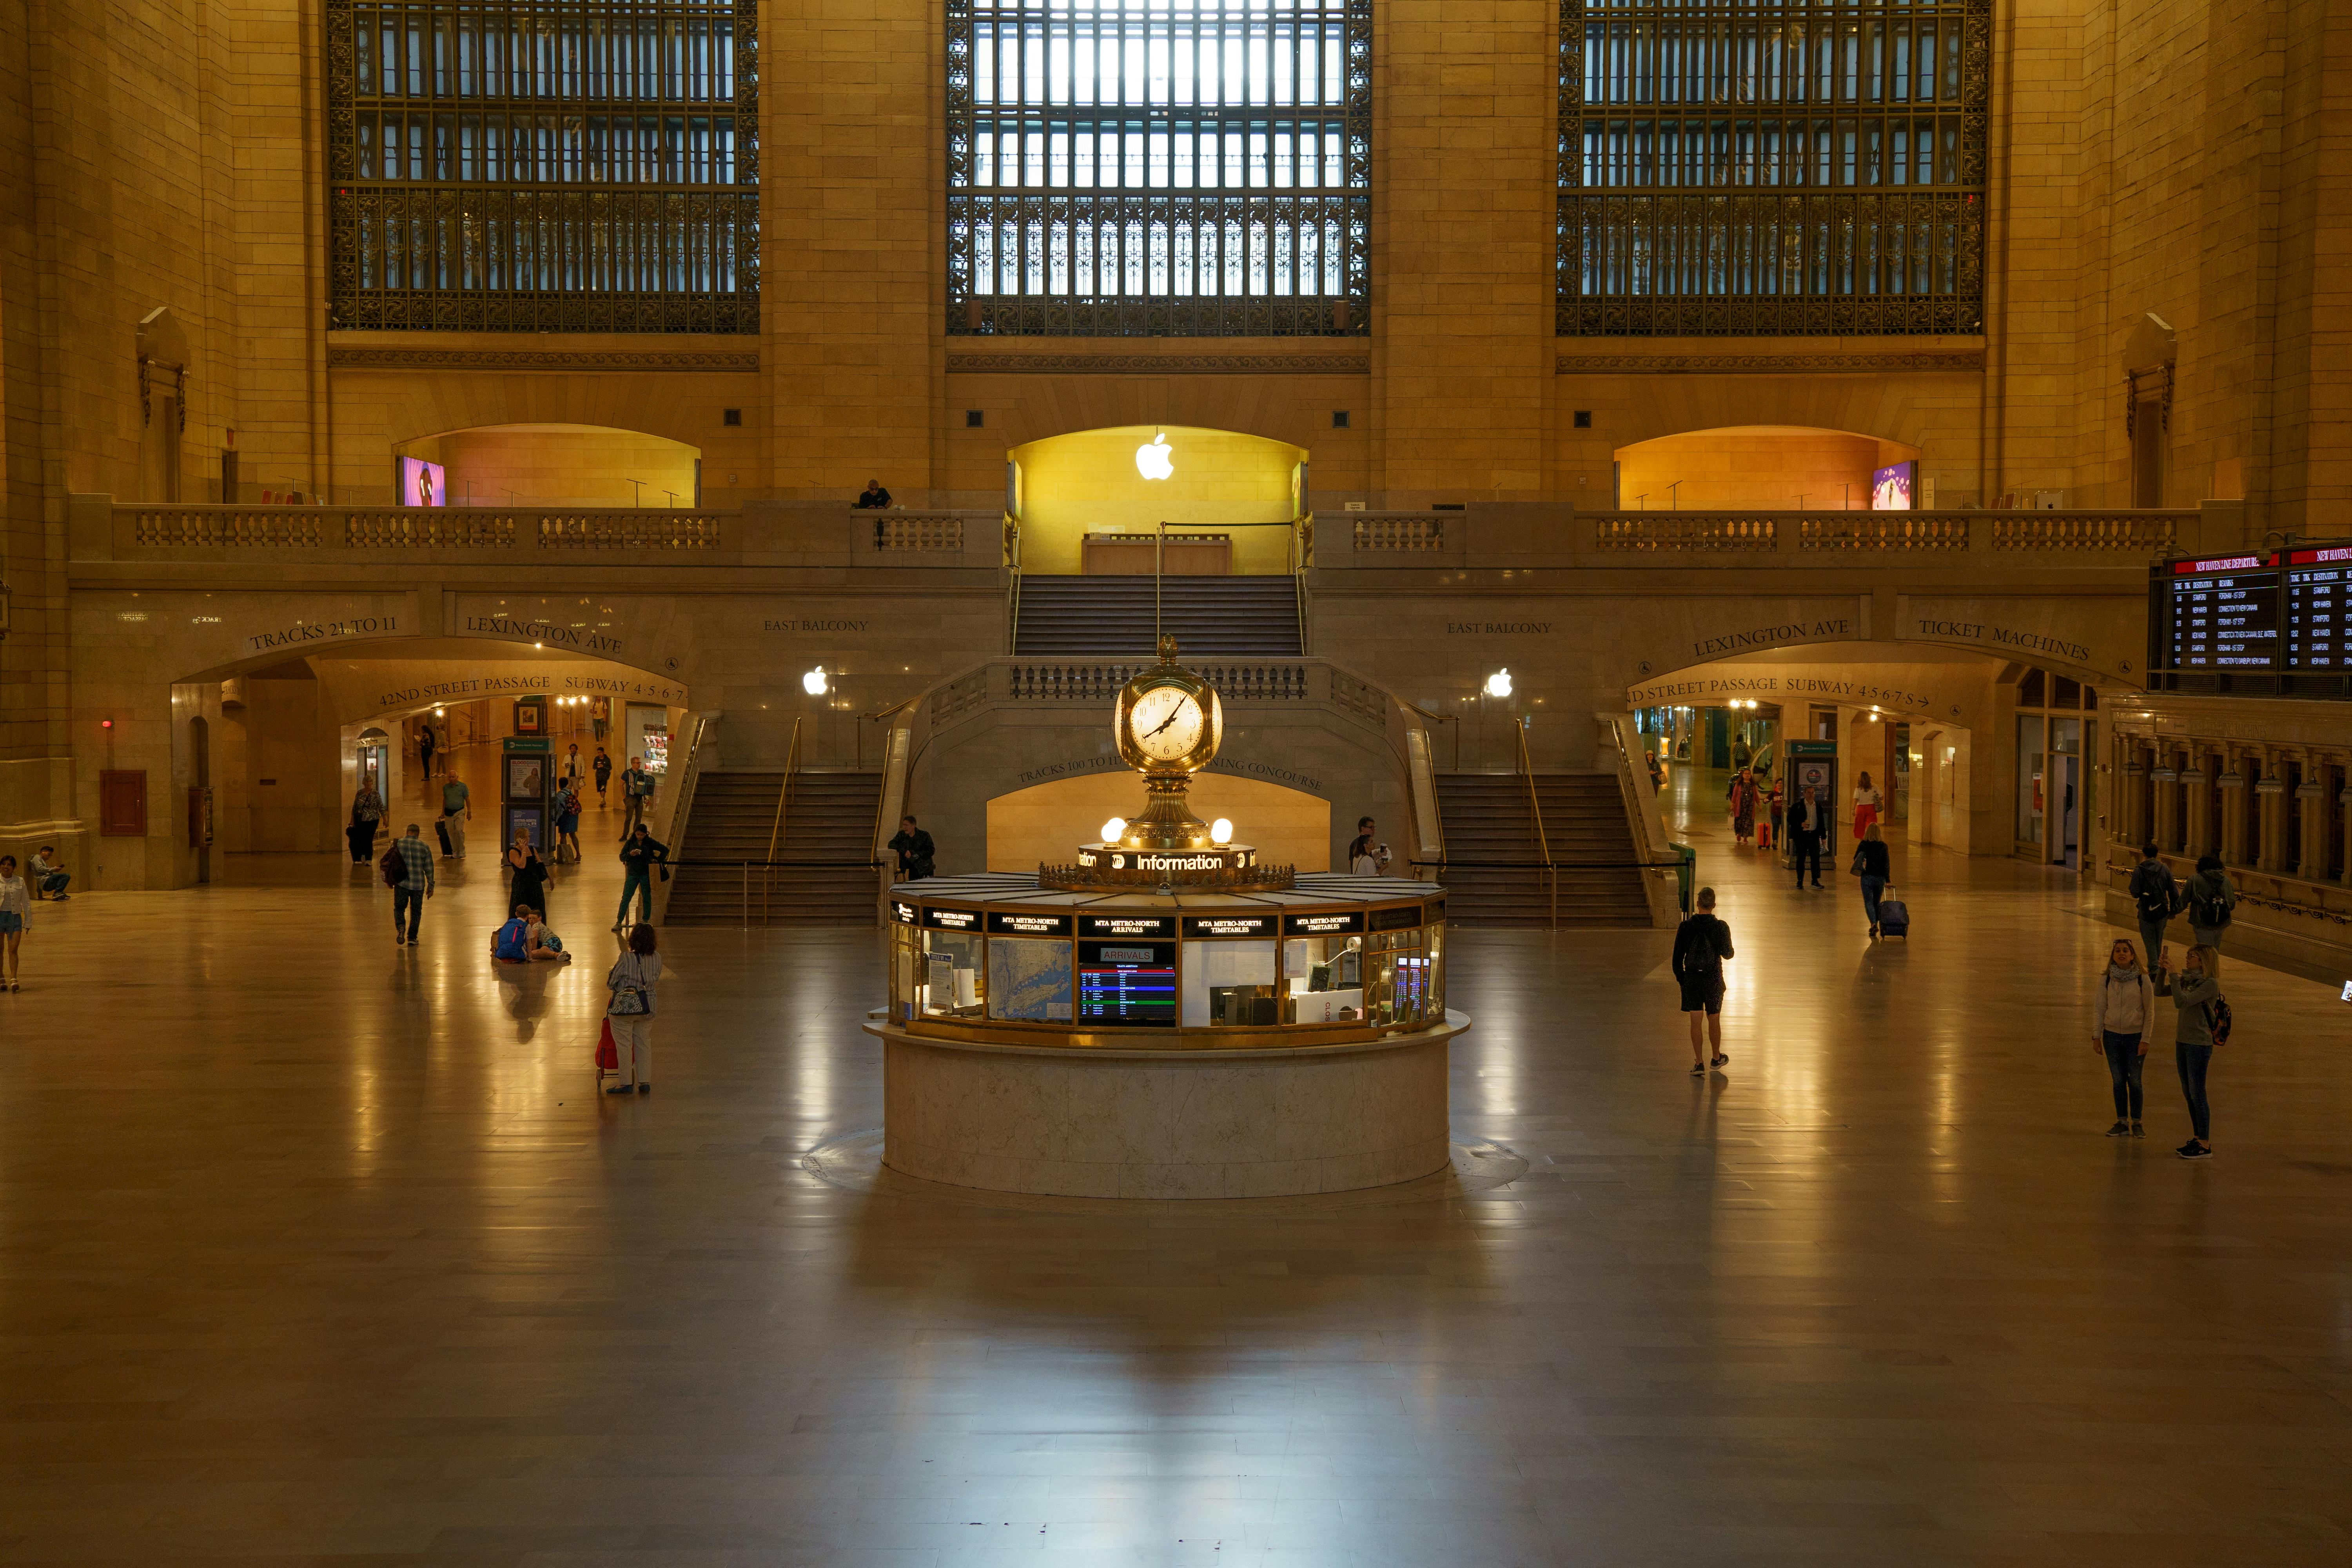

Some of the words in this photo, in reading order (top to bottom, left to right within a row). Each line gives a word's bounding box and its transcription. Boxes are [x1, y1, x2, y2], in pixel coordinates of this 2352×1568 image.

[2317, 550, 2329, 561] NEW
[2330, 549, 2348, 560] HAVEN
[2196, 561, 2205, 571] NEW
[2206, 560, 2221, 570] HAVEN
[2221, 559, 2232, 569] LINE
[2314, 572, 2338, 581] DESTINATION
[764, 621, 798, 630] EAST
[802, 621, 869, 631] BALCONY
[1447, 623, 1481, 633] EAST
[1486, 623, 1552, 633] BALCONY
[250, 624, 324, 650] TRACKS
[328, 622, 345, 636] 21
[350, 618, 377, 633] TO
[383, 617, 397, 630] 11
[466, 617, 581, 645] LEXINGTON
[586, 634, 622, 654] AVE
[1693, 623, 1806, 657] LEXINGTON
[1813, 620, 1849, 635] AVE
[1919, 619, 1985, 638] TICKET
[1992, 628, 2090, 661] MACHINES
[380, 689, 419, 706] 42ND
[424, 679, 479, 697] STREET
[485, 676, 550, 690] PASSAGE
[565, 677, 630, 692] SUBWAY
[1627, 690, 1644, 703] ND
[1648, 681, 1705, 699] STREET
[1710, 678, 1777, 691] PASSAGE
[1787, 678, 1855, 695] SUBWAY
[1149, 697, 1156, 706] 11
[1162, 693, 1170, 702] 12
[1140, 706, 1146, 716] 10
[1138, 720, 1142, 730] 9
[1190, 720, 1196, 729] 3
[1142, 734, 1146, 743] 8
[1187, 733, 1193, 742] 4
[1151, 742, 1156, 751] 7
[1163, 746, 1169, 755] 6
[1176, 743, 1182, 752] 5
[1018, 763, 1065, 782] TRACKS
[1068, 760, 1085, 771] 100
[1088, 757, 1105, 768] TO
[1109, 756, 1122, 765] 117
[1210, 757, 1245, 770] NING
[1248, 763, 1322, 790] CONCOURSE
[1079, 851, 1096, 867] ation
[1138, 855, 1222, 870] Information
[1104, 951, 1150, 960] ARRIVALS
